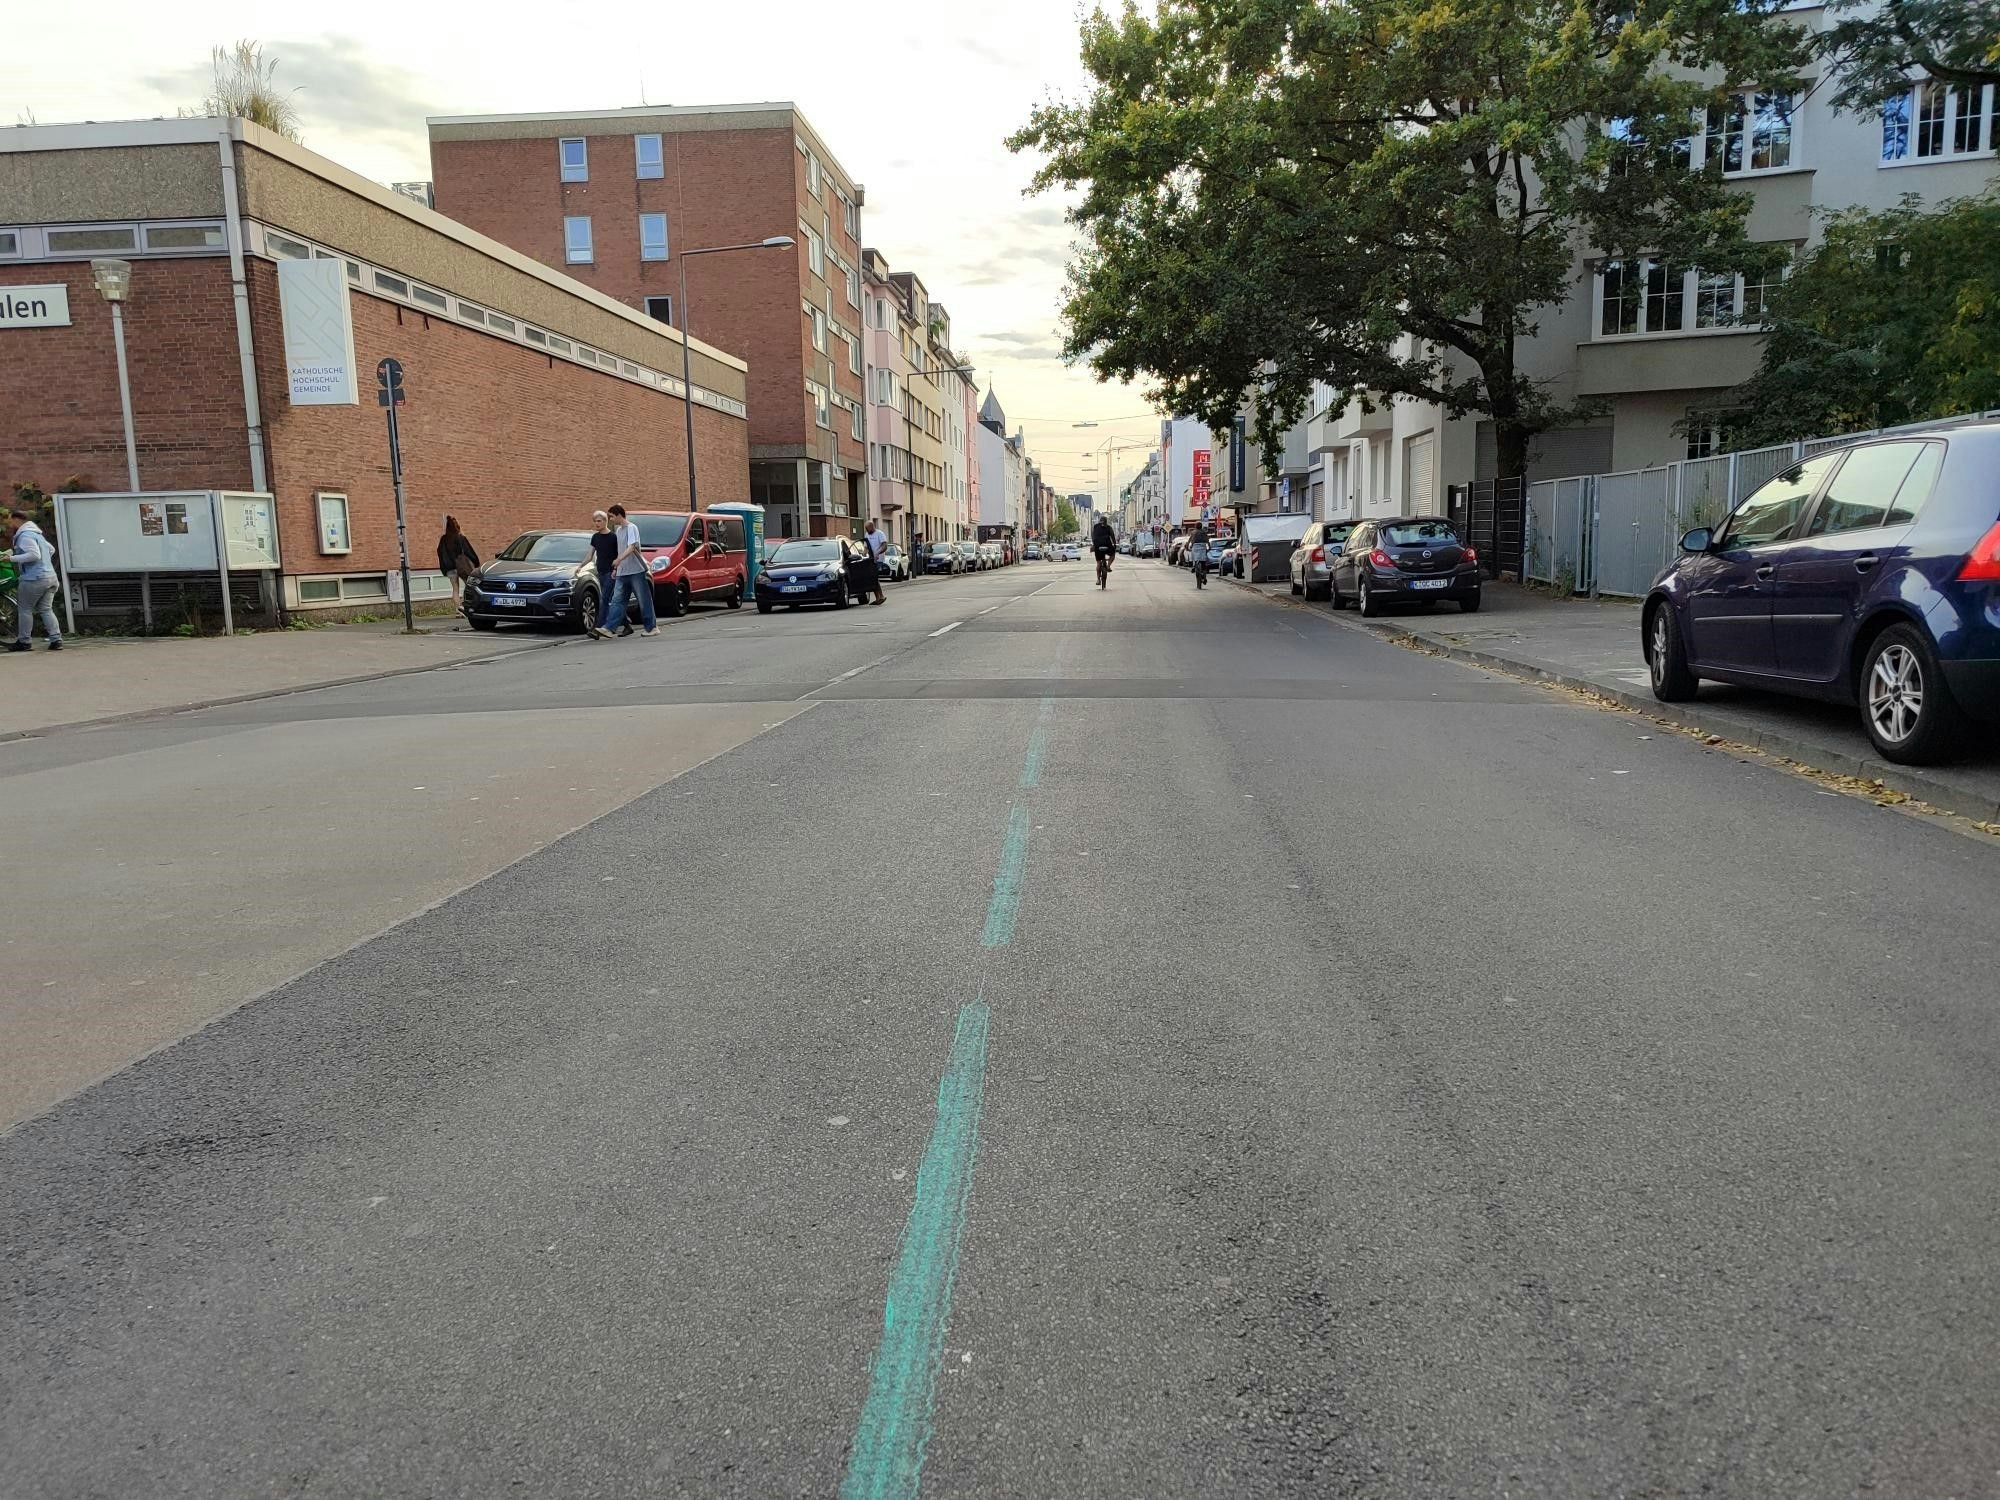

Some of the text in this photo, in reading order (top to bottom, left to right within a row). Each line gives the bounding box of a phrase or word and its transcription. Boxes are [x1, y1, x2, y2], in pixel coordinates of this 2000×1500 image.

[292, 367, 344, 375] KATHOLISCHE
[293, 376, 340, 384] HOCHSCHUL
[293, 385, 332, 393] GEMEINDE
